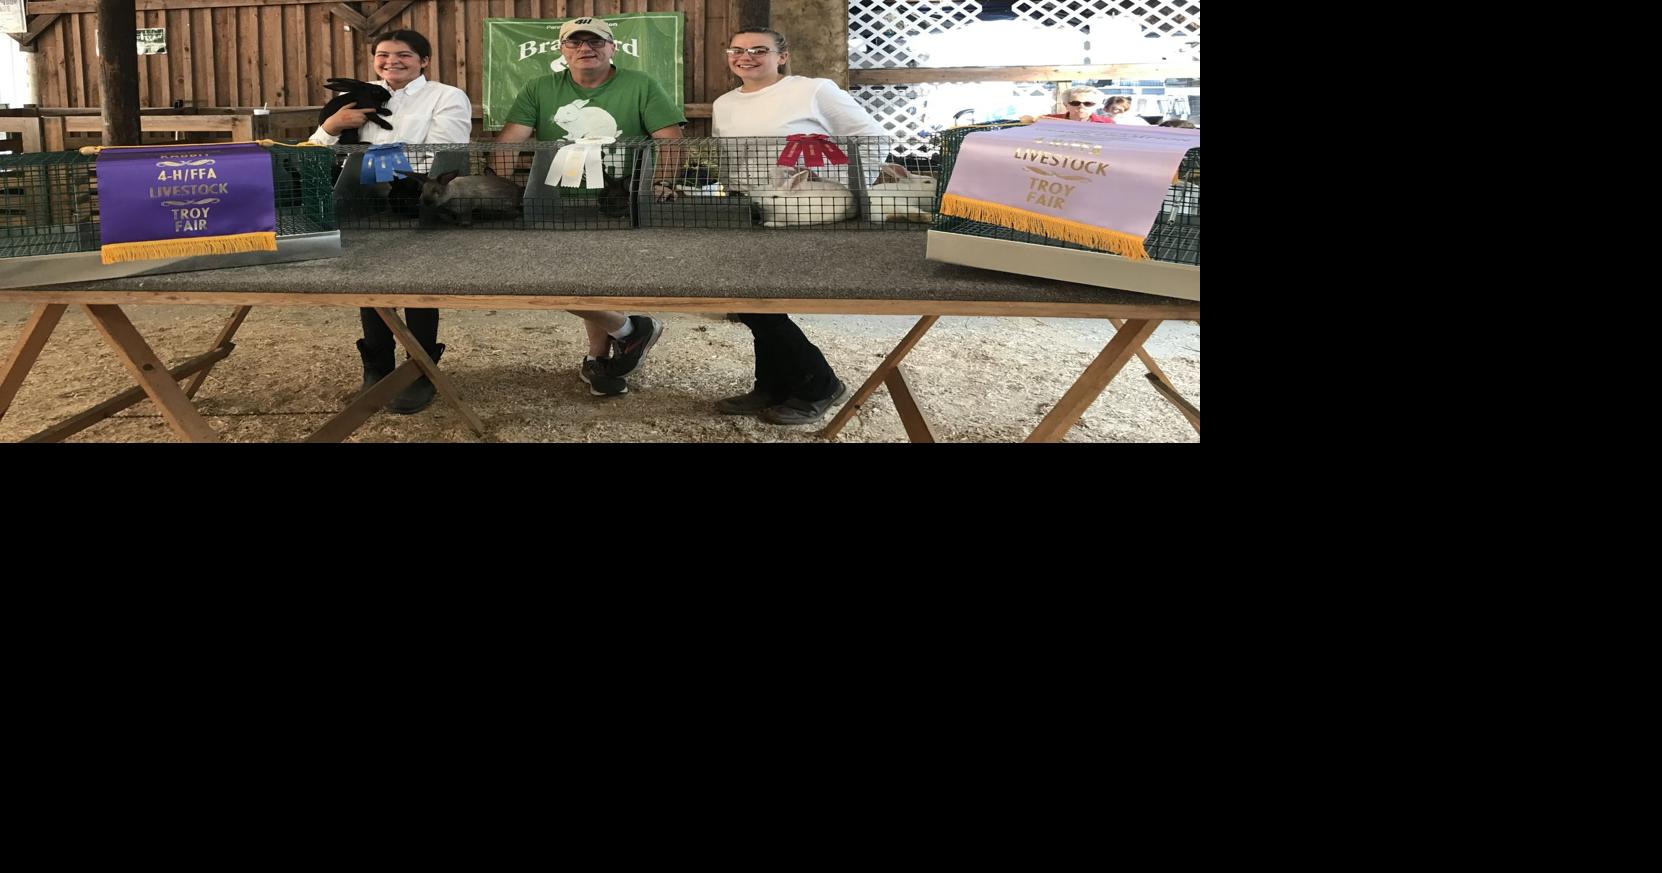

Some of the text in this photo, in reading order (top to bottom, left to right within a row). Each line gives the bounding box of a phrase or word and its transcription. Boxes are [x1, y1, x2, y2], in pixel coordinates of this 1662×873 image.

[518, 38, 640, 62] Brard
[1014, 147, 1109, 176] LIVESTOCK
[158, 168, 217, 182] 4-H/FFA
[149, 182, 229, 198] LIVESTOCK
[1029, 177, 1076, 197] TROY
[1026, 191, 1065, 209] FAIR
[171, 207, 210, 221] TROY
[175, 219, 208, 232] FAIR
